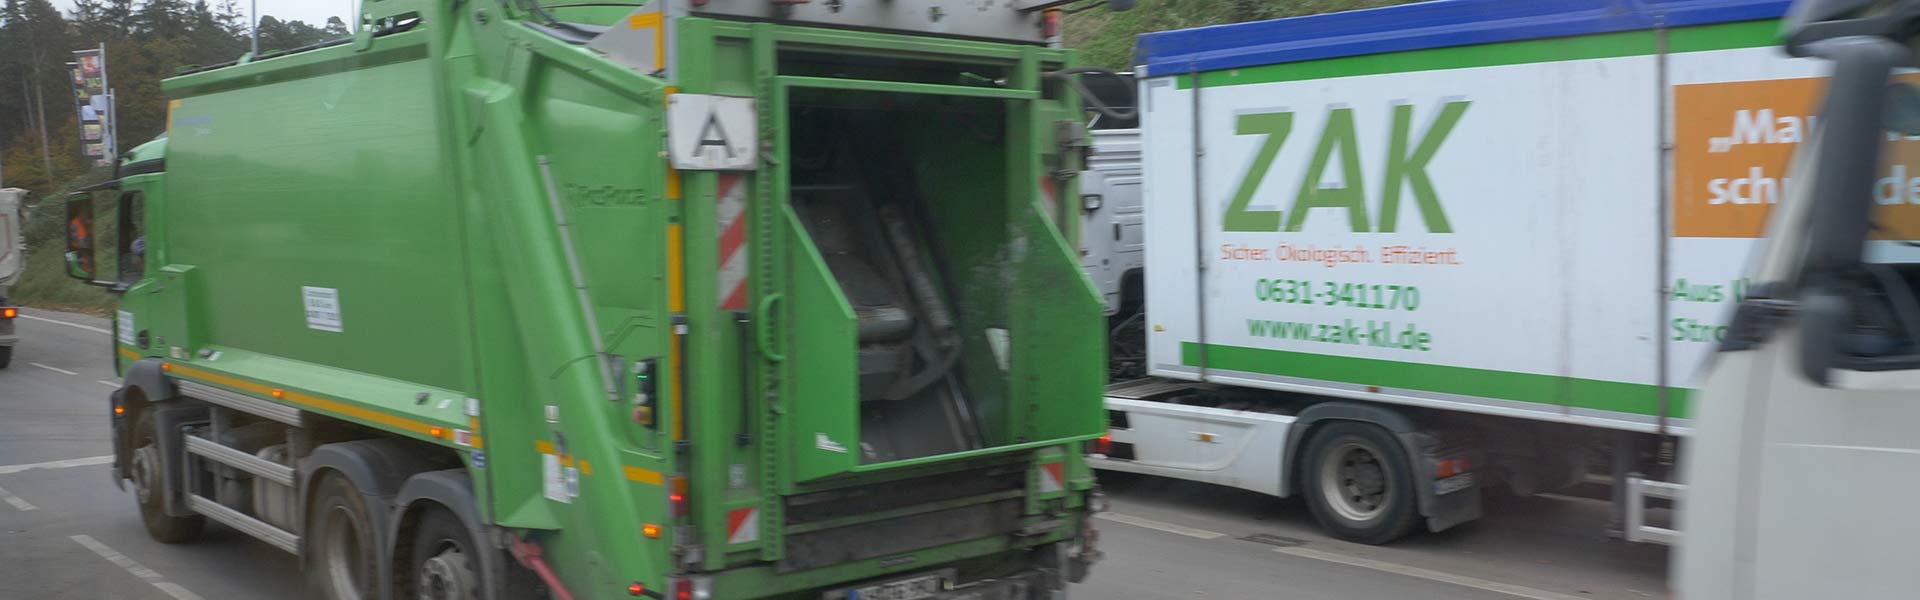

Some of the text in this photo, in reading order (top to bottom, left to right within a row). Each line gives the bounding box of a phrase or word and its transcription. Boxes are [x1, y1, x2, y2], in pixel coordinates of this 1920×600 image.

[691, 111, 736, 157] A
[1221, 98, 1473, 234] ZAK
[1220, 242, 1464, 268] Sicher. Ökologisch. Effizient.
[1255, 278, 1421, 311] 0631-341170
[1673, 279, 1726, 302] Aus
[1247, 318, 1432, 351] www.zak-kl.de
